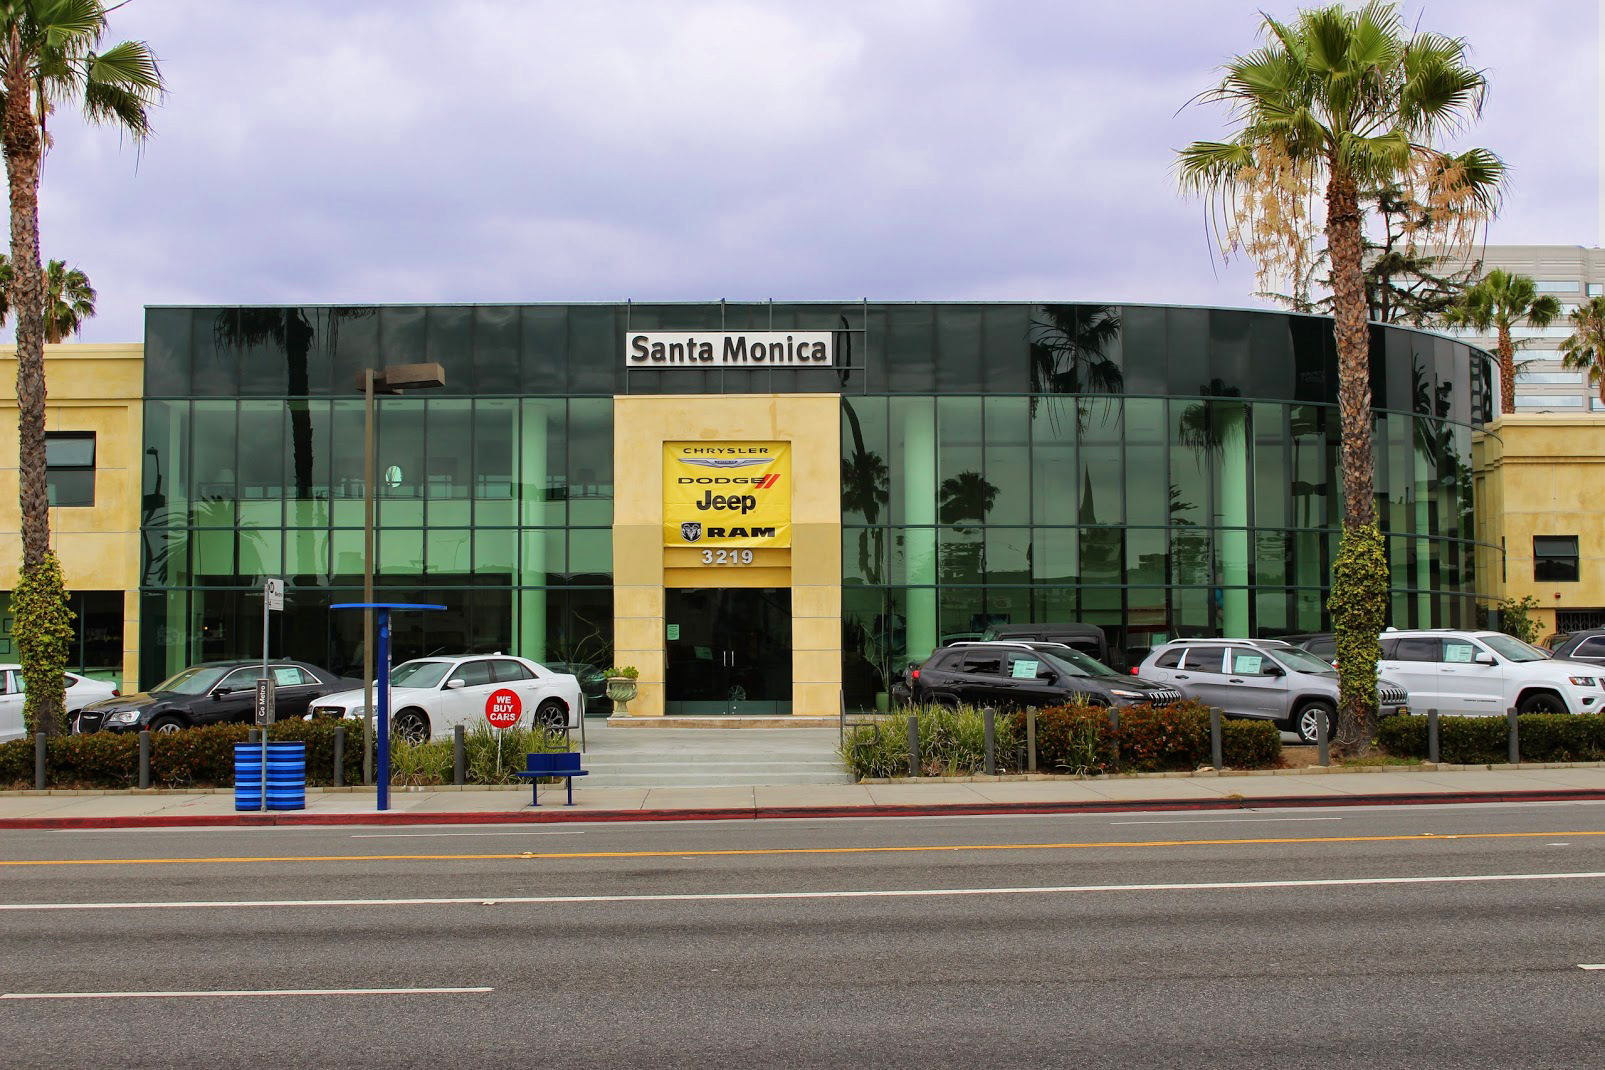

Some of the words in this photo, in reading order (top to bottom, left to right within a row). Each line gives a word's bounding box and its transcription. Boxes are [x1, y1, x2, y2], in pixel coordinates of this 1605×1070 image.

[631, 335, 714, 362] Santa
[722, 335, 828, 362] Monica
[696, 490, 756, 514] Jeep
[707, 527, 776, 537] RAM
[701, 549, 753, 564] 3219
[496, 696, 511, 704] WE
[258, 706, 266, 717] Go
[493, 704, 514, 712] BUY
[489, 713, 516, 721] CARS
